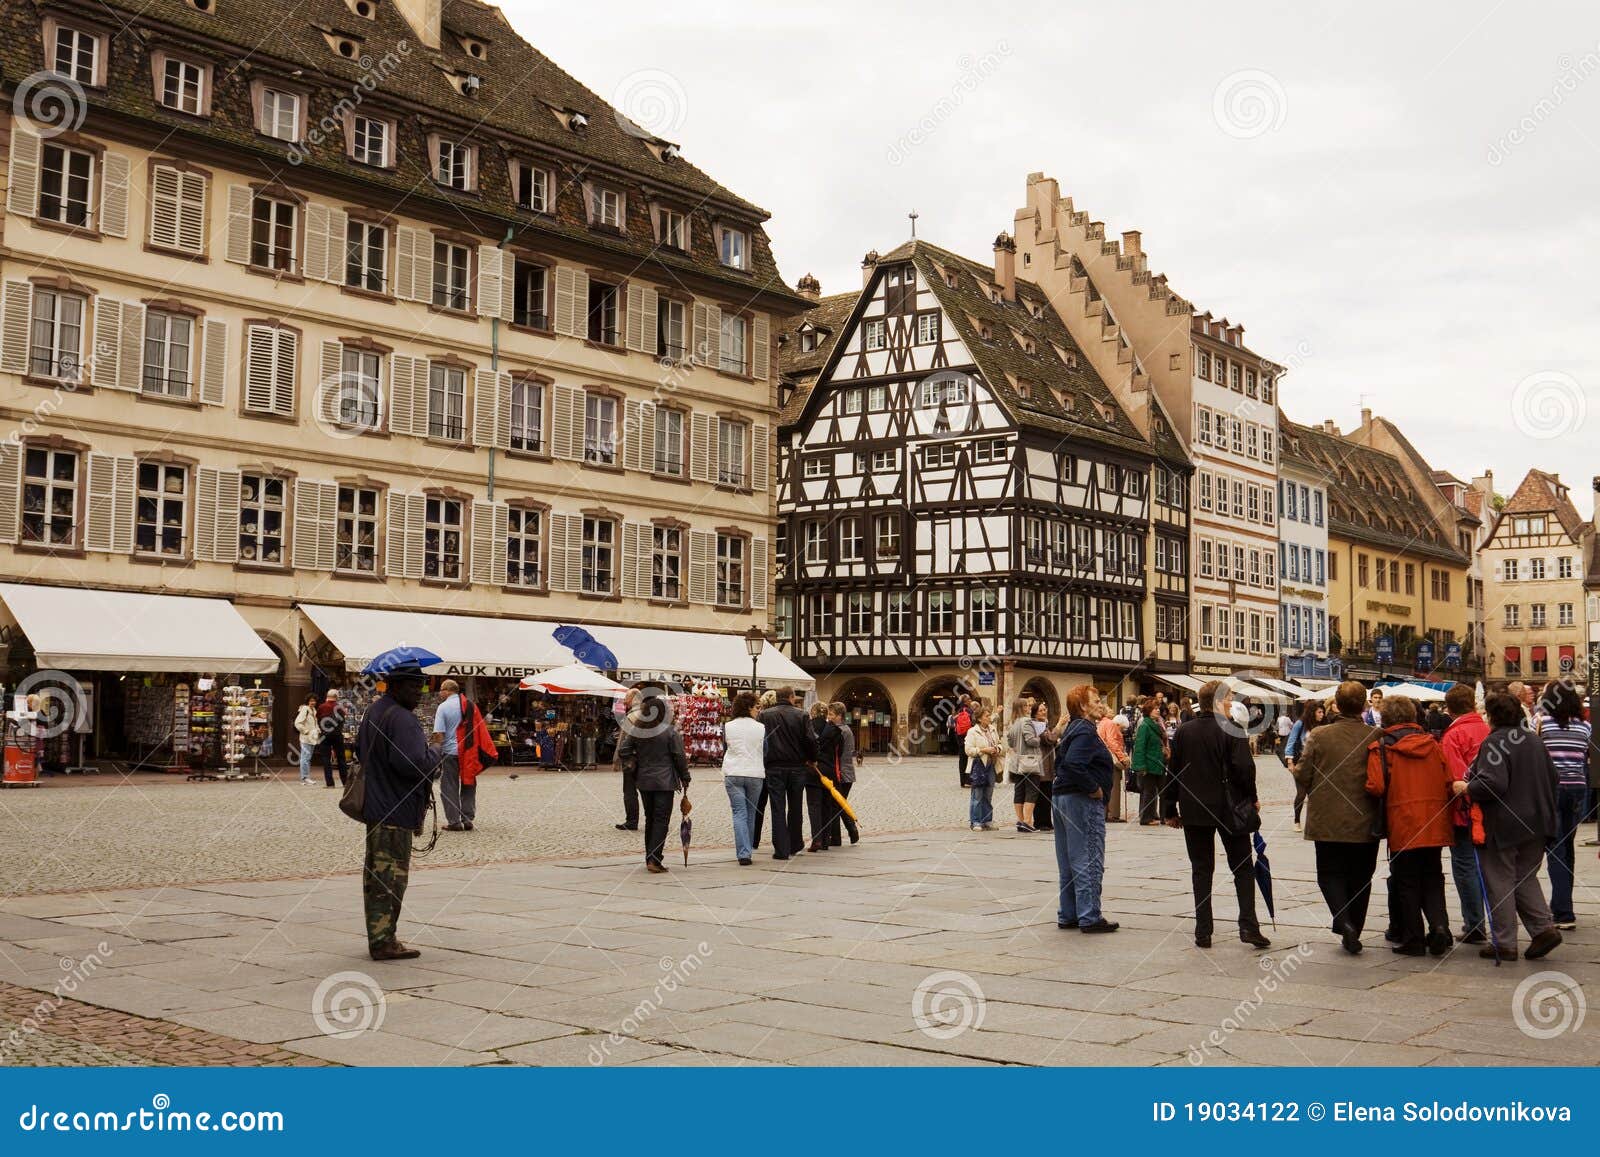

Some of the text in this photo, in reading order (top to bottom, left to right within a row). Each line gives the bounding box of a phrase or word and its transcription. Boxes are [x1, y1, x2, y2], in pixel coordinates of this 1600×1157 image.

[446, 665, 487, 676] AUX
[620, 671, 641, 681] DE
[648, 672, 666, 682] LA
